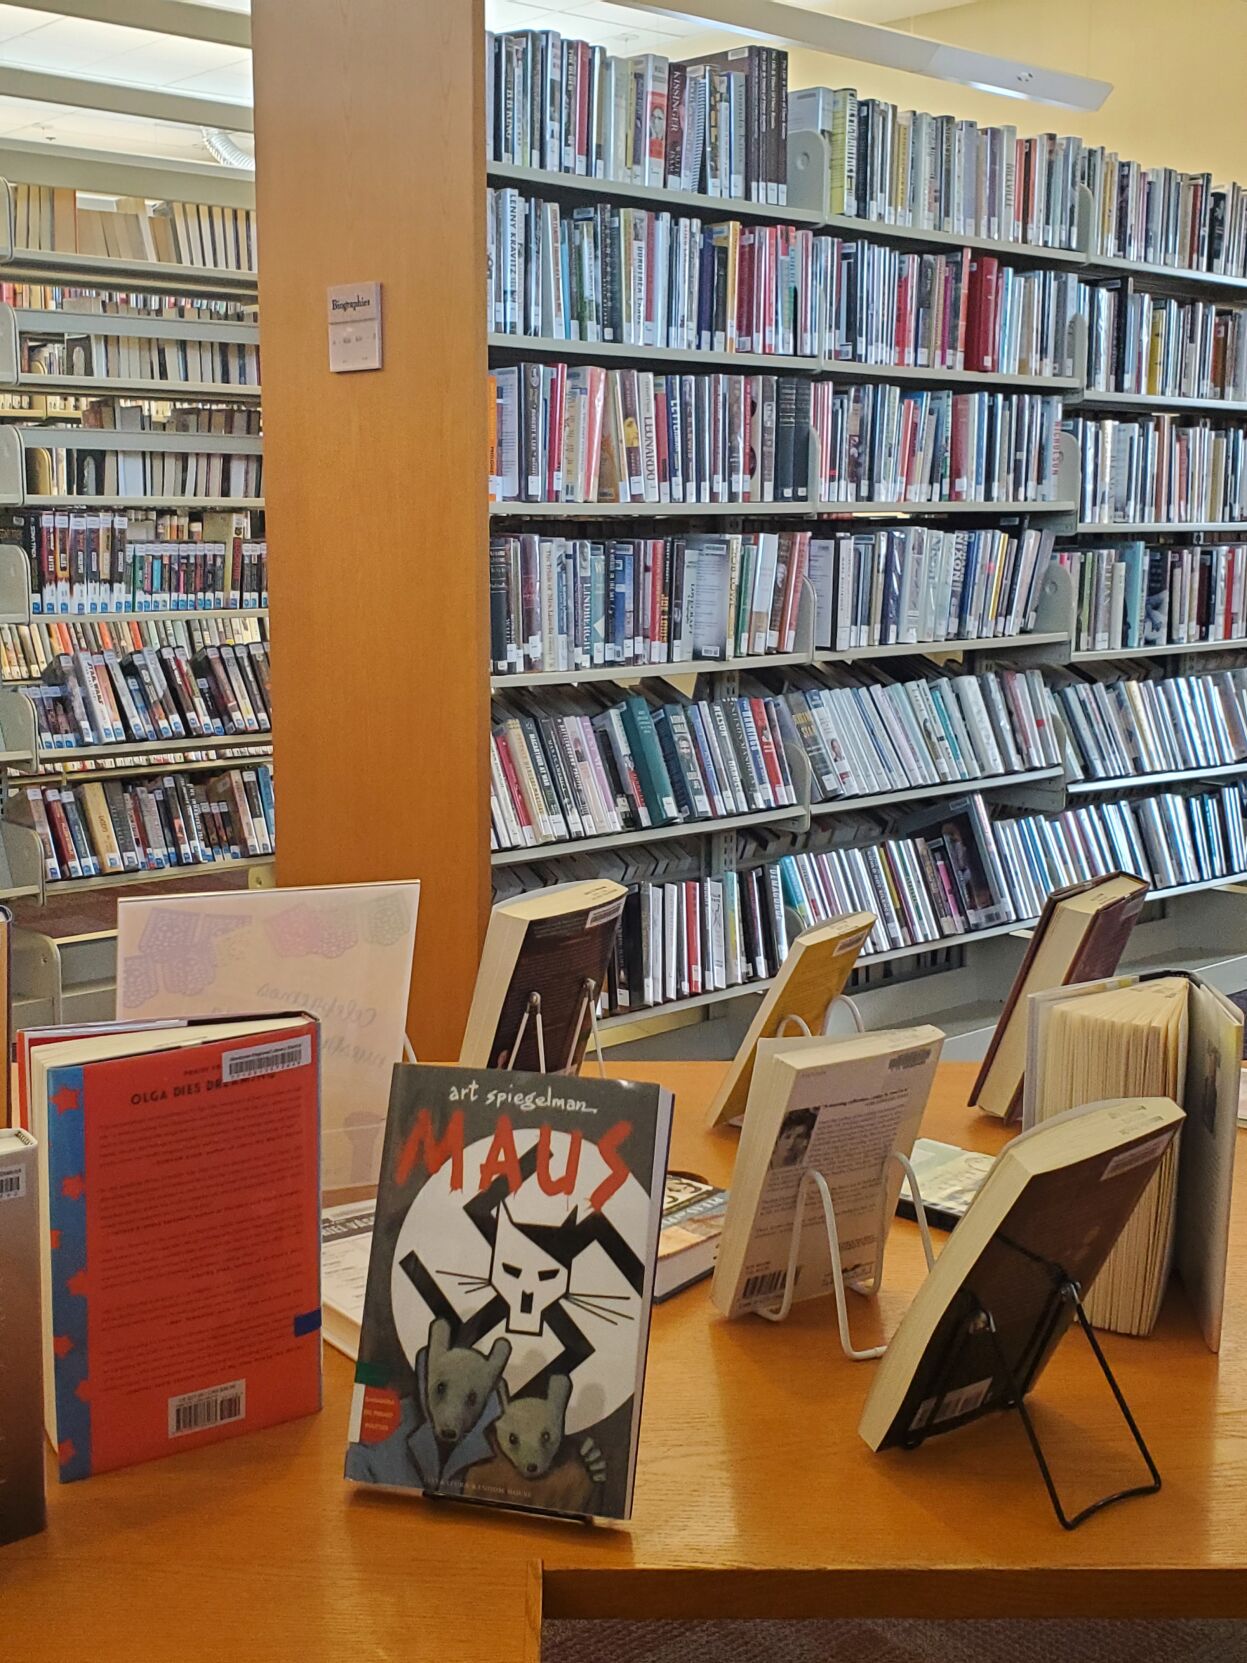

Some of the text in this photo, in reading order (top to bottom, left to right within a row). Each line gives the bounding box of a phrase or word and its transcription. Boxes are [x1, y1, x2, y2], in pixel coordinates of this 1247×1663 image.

[671, 71, 681, 131] KISSINGER
[1005, 163, 1014, 208] MELVILLE
[332, 294, 370, 312] Biographies
[644, 417, 655, 480] LEONARDO
[1052, 421, 1061, 475] NICHOLSON
[953, 533, 964, 580] NIXON
[583, 583, 591, 650] LINDBERGH
[87, 661, 97, 681] STAR
[529, 733, 545, 766] MACARTHUR
[558, 725, 582, 790] BATTLEGROUND PACIFIC
[713, 706, 740, 792] NELSON MANDEL
[770, 869, 782, 920] DEMAGOGUE
[873, 875, 882, 888] NOT
[131, 1089, 167, 1104] OLGA
[173, 1083, 200, 1097] DIES
[449, 1080, 598, 1114] art spiegelman
[394, 1107, 634, 1214] MAUS
